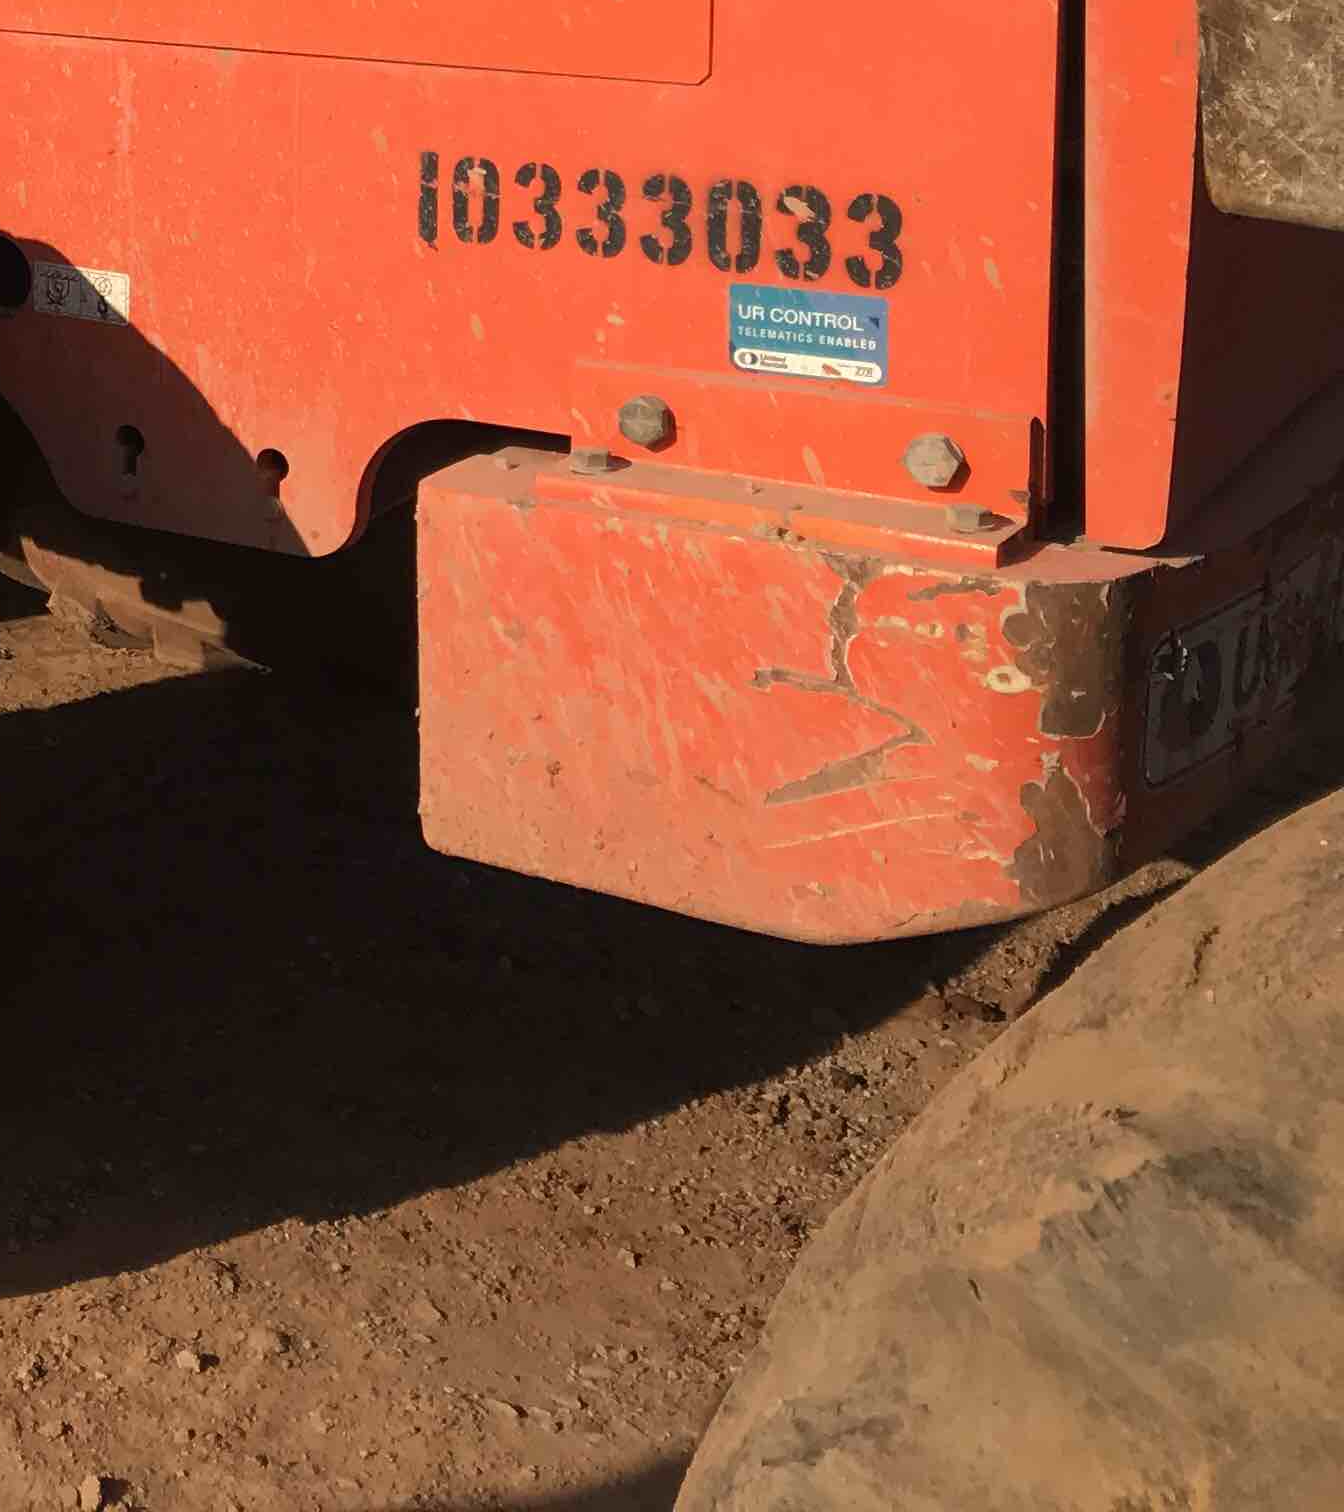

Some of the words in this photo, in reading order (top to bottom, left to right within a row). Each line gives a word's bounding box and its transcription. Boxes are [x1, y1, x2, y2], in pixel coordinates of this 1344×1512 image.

[416, 150, 905, 291] 10333033
[737, 303, 765, 322] UR
[769, 307, 865, 332] CONTROL
[737, 325, 813, 344] TELEMATICS
[818, 335, 877, 351] ENABLED
